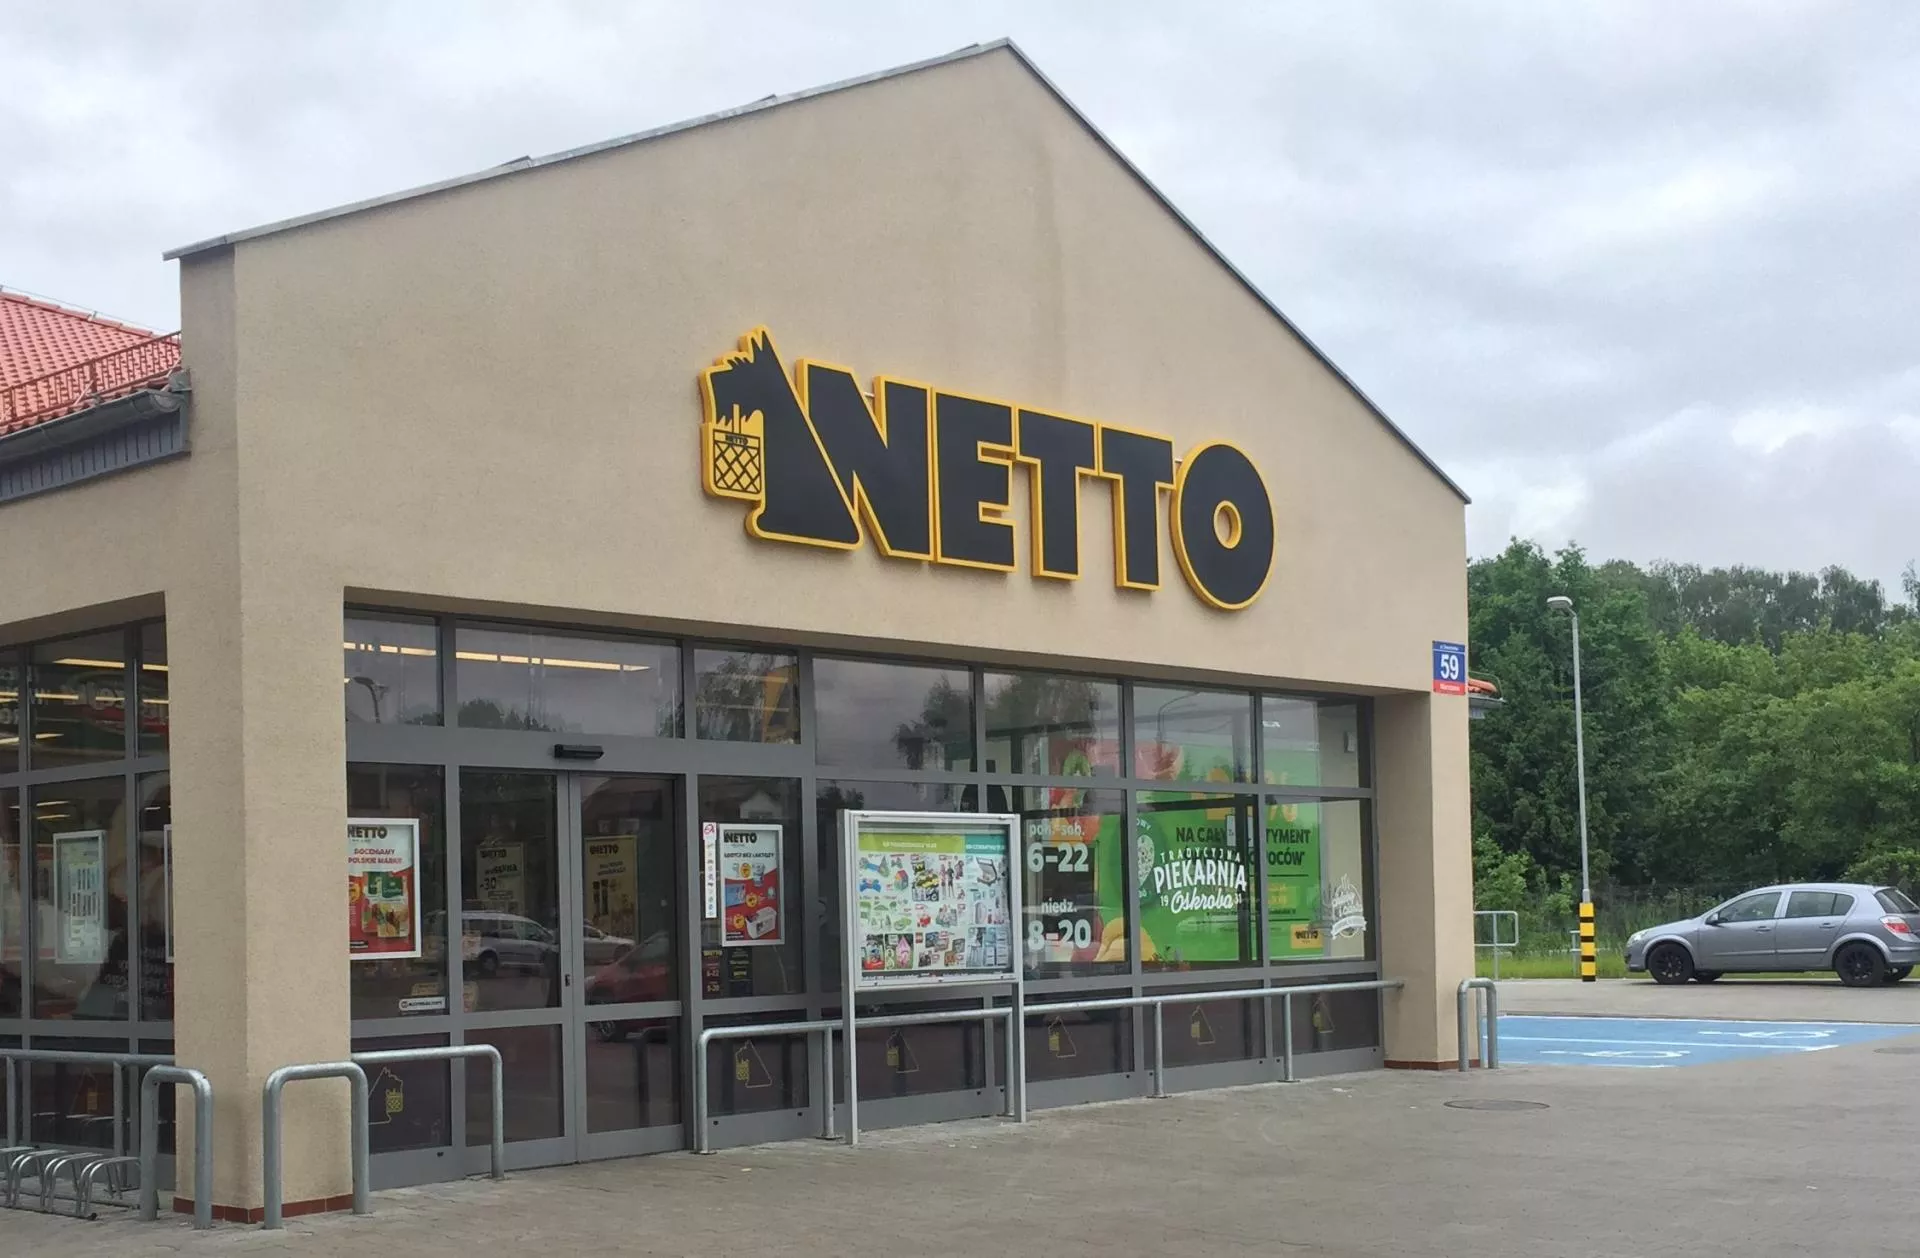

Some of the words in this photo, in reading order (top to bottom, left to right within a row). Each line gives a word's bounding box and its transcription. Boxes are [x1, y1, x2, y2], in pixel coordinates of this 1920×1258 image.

[794, 356, 1276, 611] NETTO
[1440, 653, 1459, 680] 59
[724, 832, 757, 844] NETTO
[1175, 827, 1195, 843] NA
[1160, 846, 1241, 863] TRADYCYJNA
[1153, 859, 1247, 894] PIEKARNIA
[1041, 897, 1078, 914] niedz.
[1160, 895, 1169, 906] 19
[1171, 887, 1234, 914] Oskroba
